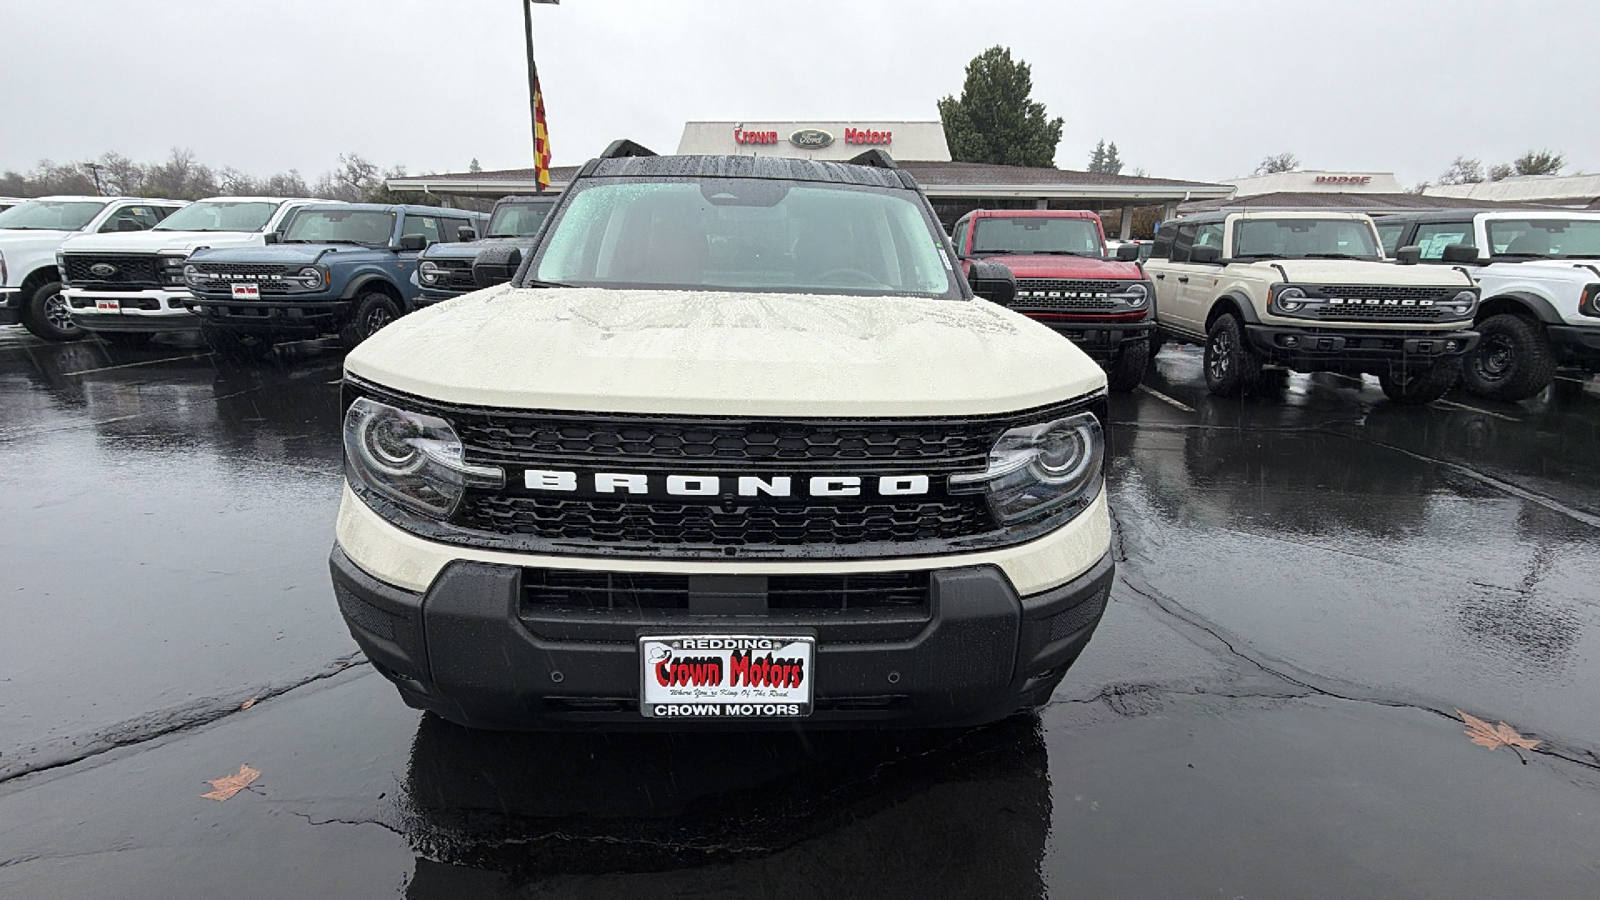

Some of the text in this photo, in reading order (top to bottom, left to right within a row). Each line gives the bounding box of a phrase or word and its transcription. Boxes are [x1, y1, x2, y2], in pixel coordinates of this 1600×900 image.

[734, 127, 892, 144] Crown Ford Motors
[1316, 176, 1372, 184] DODGE
[1329, 298, 1434, 306] BRONCO
[524, 469, 929, 497] BRONCO
[683, 639, 773, 650] REDDING
[655, 652, 802, 689] Crown Motors
[693, 688, 718, 699] You're
[720, 689, 738, 698] King
[741, 689, 751, 699] Of
[753, 689, 766, 697] The
[768, 689, 789, 698] Road
[654, 704, 800, 716] CROWN MOTORS
